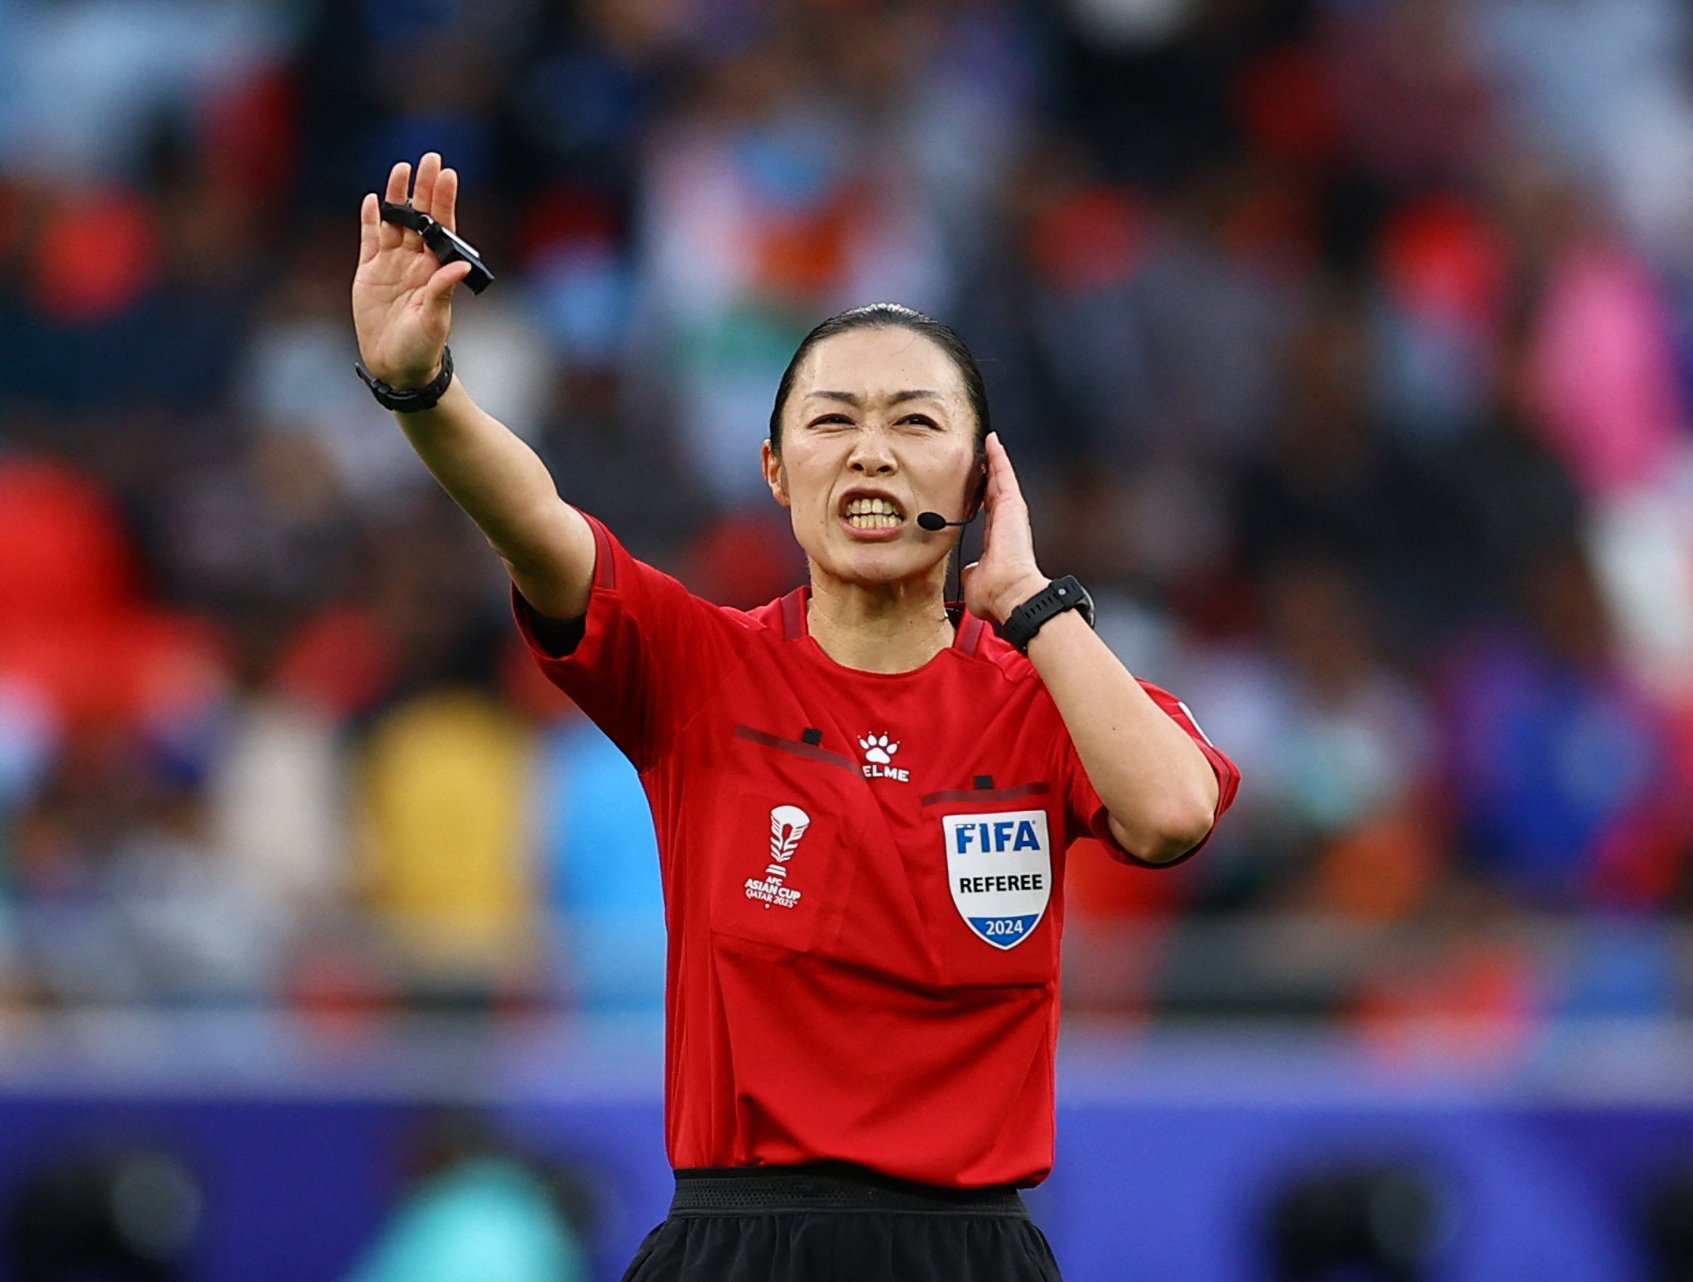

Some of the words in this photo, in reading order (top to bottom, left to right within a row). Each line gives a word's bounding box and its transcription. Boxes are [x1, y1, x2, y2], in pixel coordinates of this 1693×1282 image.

[862, 764, 910, 783] ELME
[954, 820, 1041, 854] FIFA
[744, 878, 779, 895] ASIAN
[778, 887, 801, 901] CUP
[765, 875, 783, 886] AFC
[959, 874, 1043, 894] REFEREE
[745, 888, 773, 903] QATAR
[985, 919, 1024, 936] 2024
